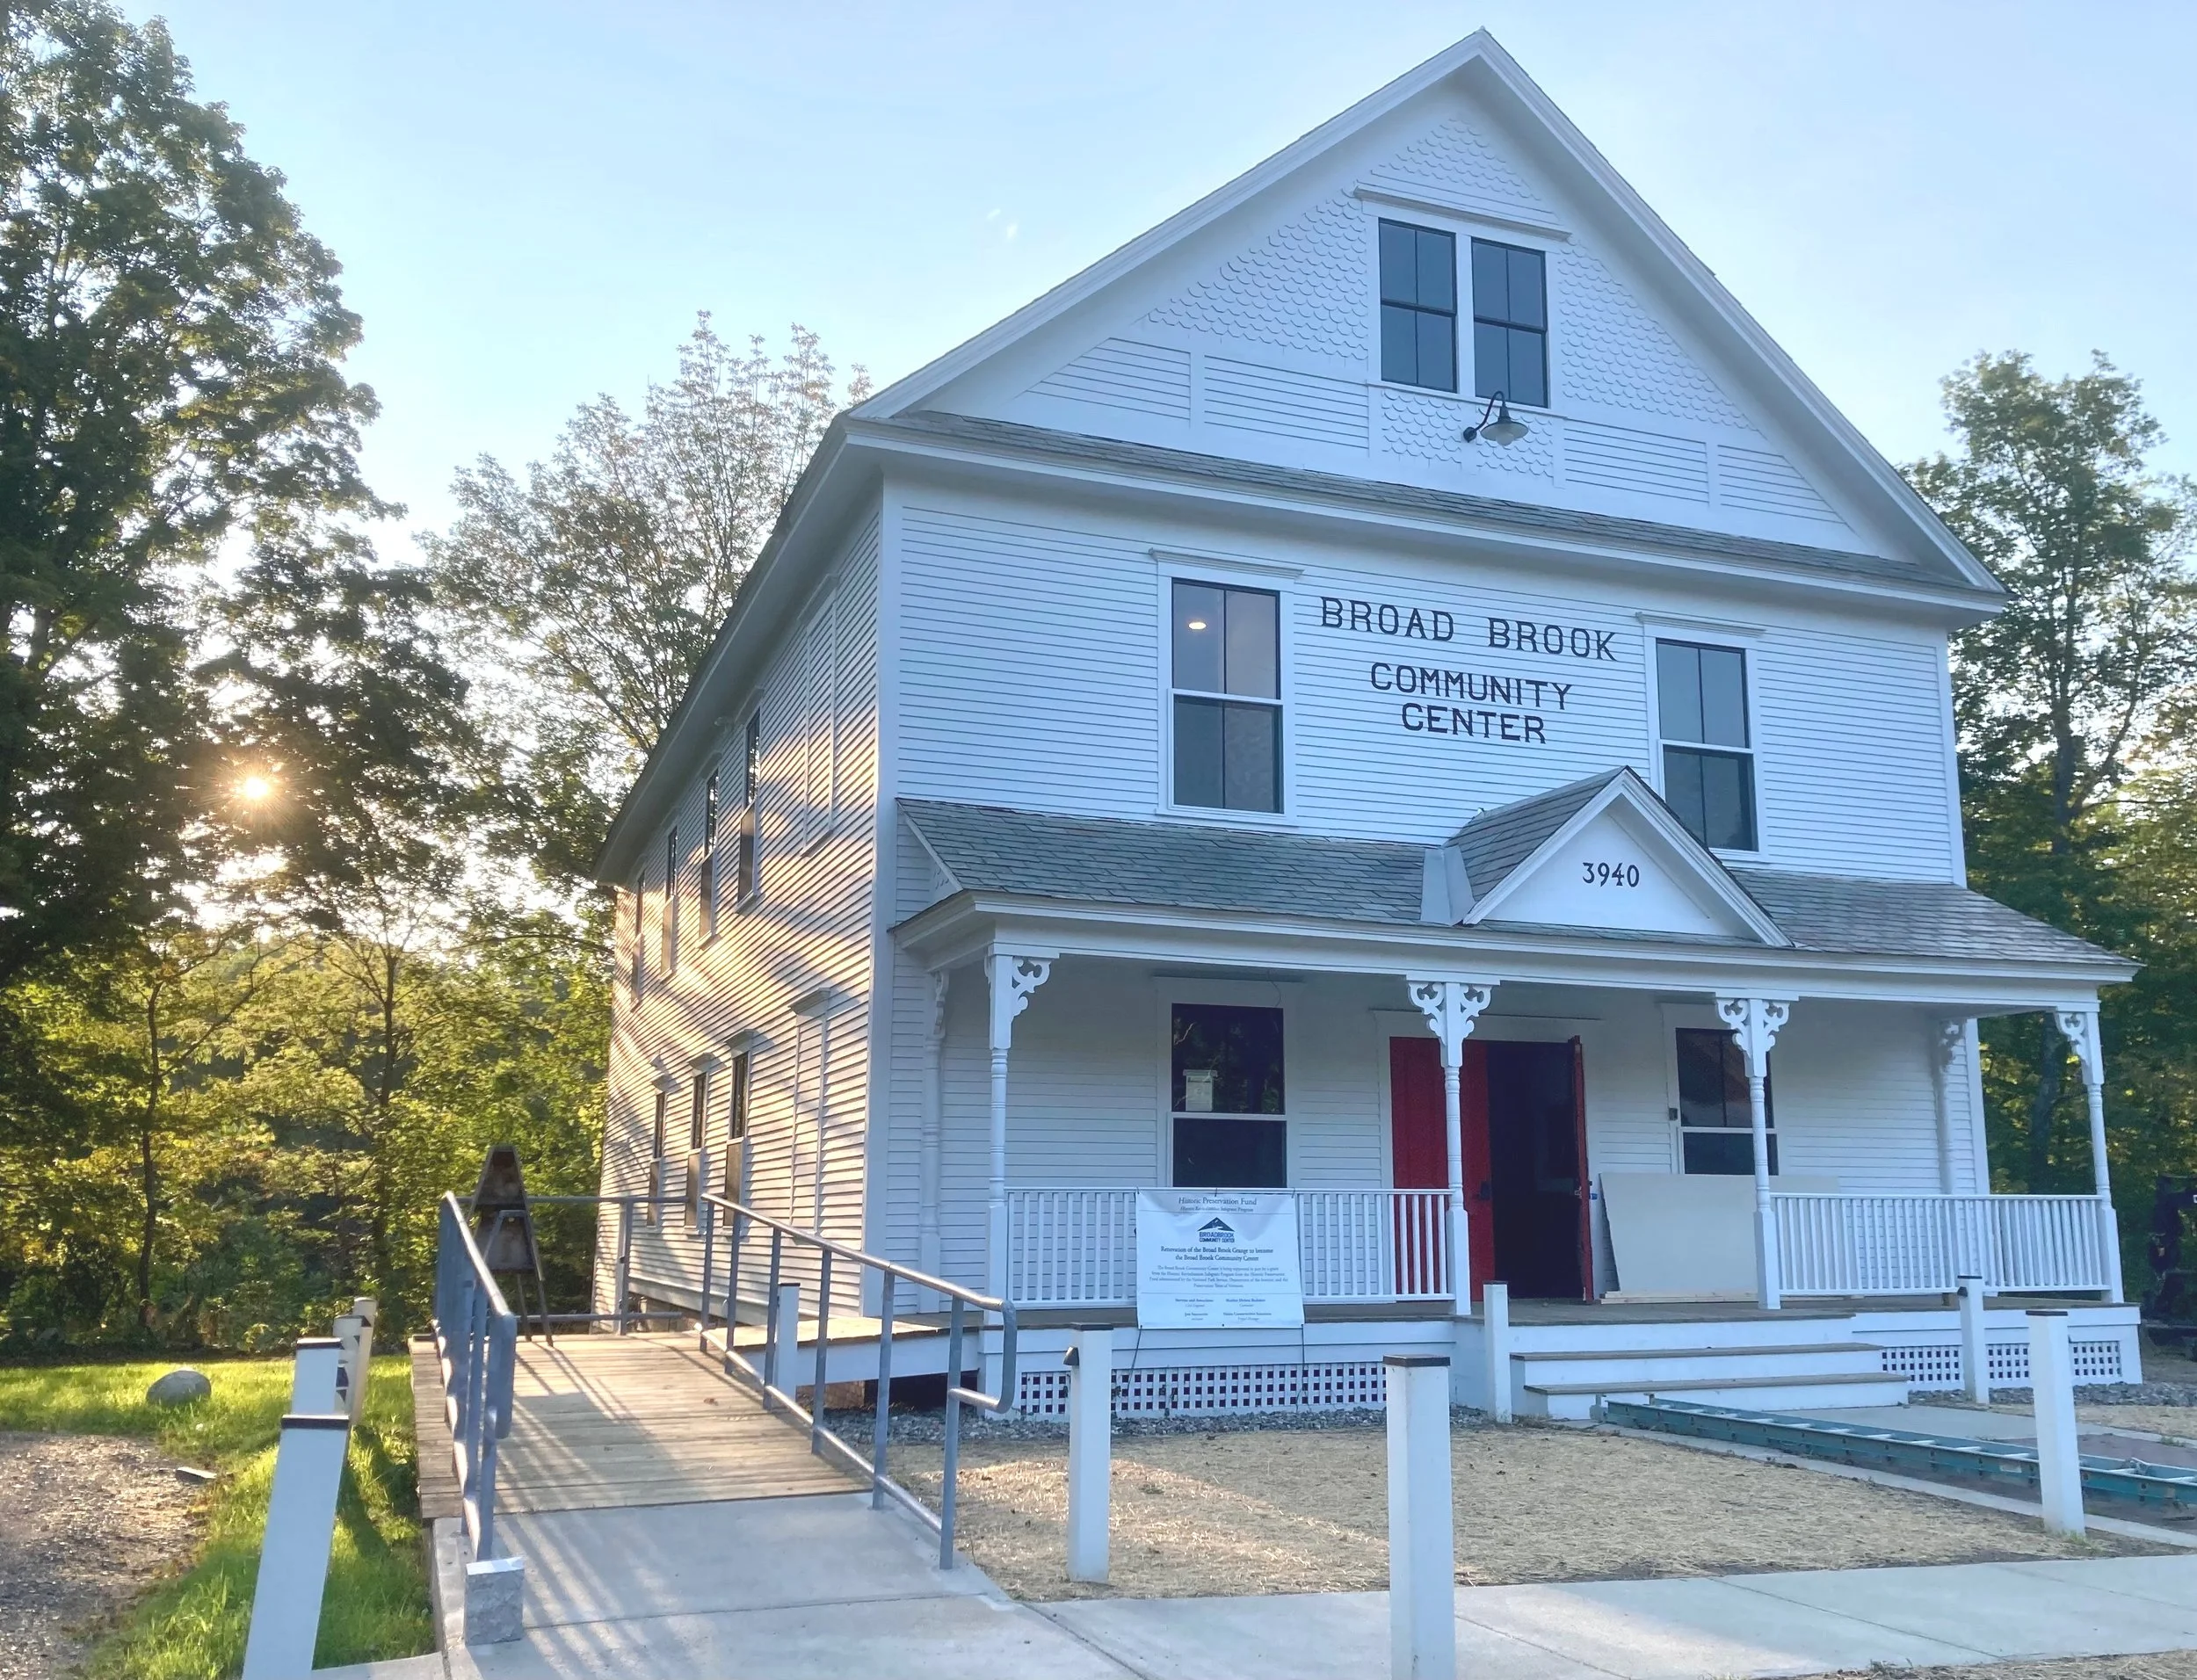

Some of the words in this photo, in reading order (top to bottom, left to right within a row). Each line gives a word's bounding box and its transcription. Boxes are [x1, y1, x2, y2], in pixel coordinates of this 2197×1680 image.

[1321, 597, 1454, 641] BROAD
[1488, 617, 1617, 662] BROOK
[1371, 662, 1572, 710] COMMUNITY
[1402, 702, 1546, 744] CENTER
[1582, 862, 1640, 887] 3940
[1202, 1197, 1239, 1206] Preservation
[1215, 1254, 1243, 1263] Community
